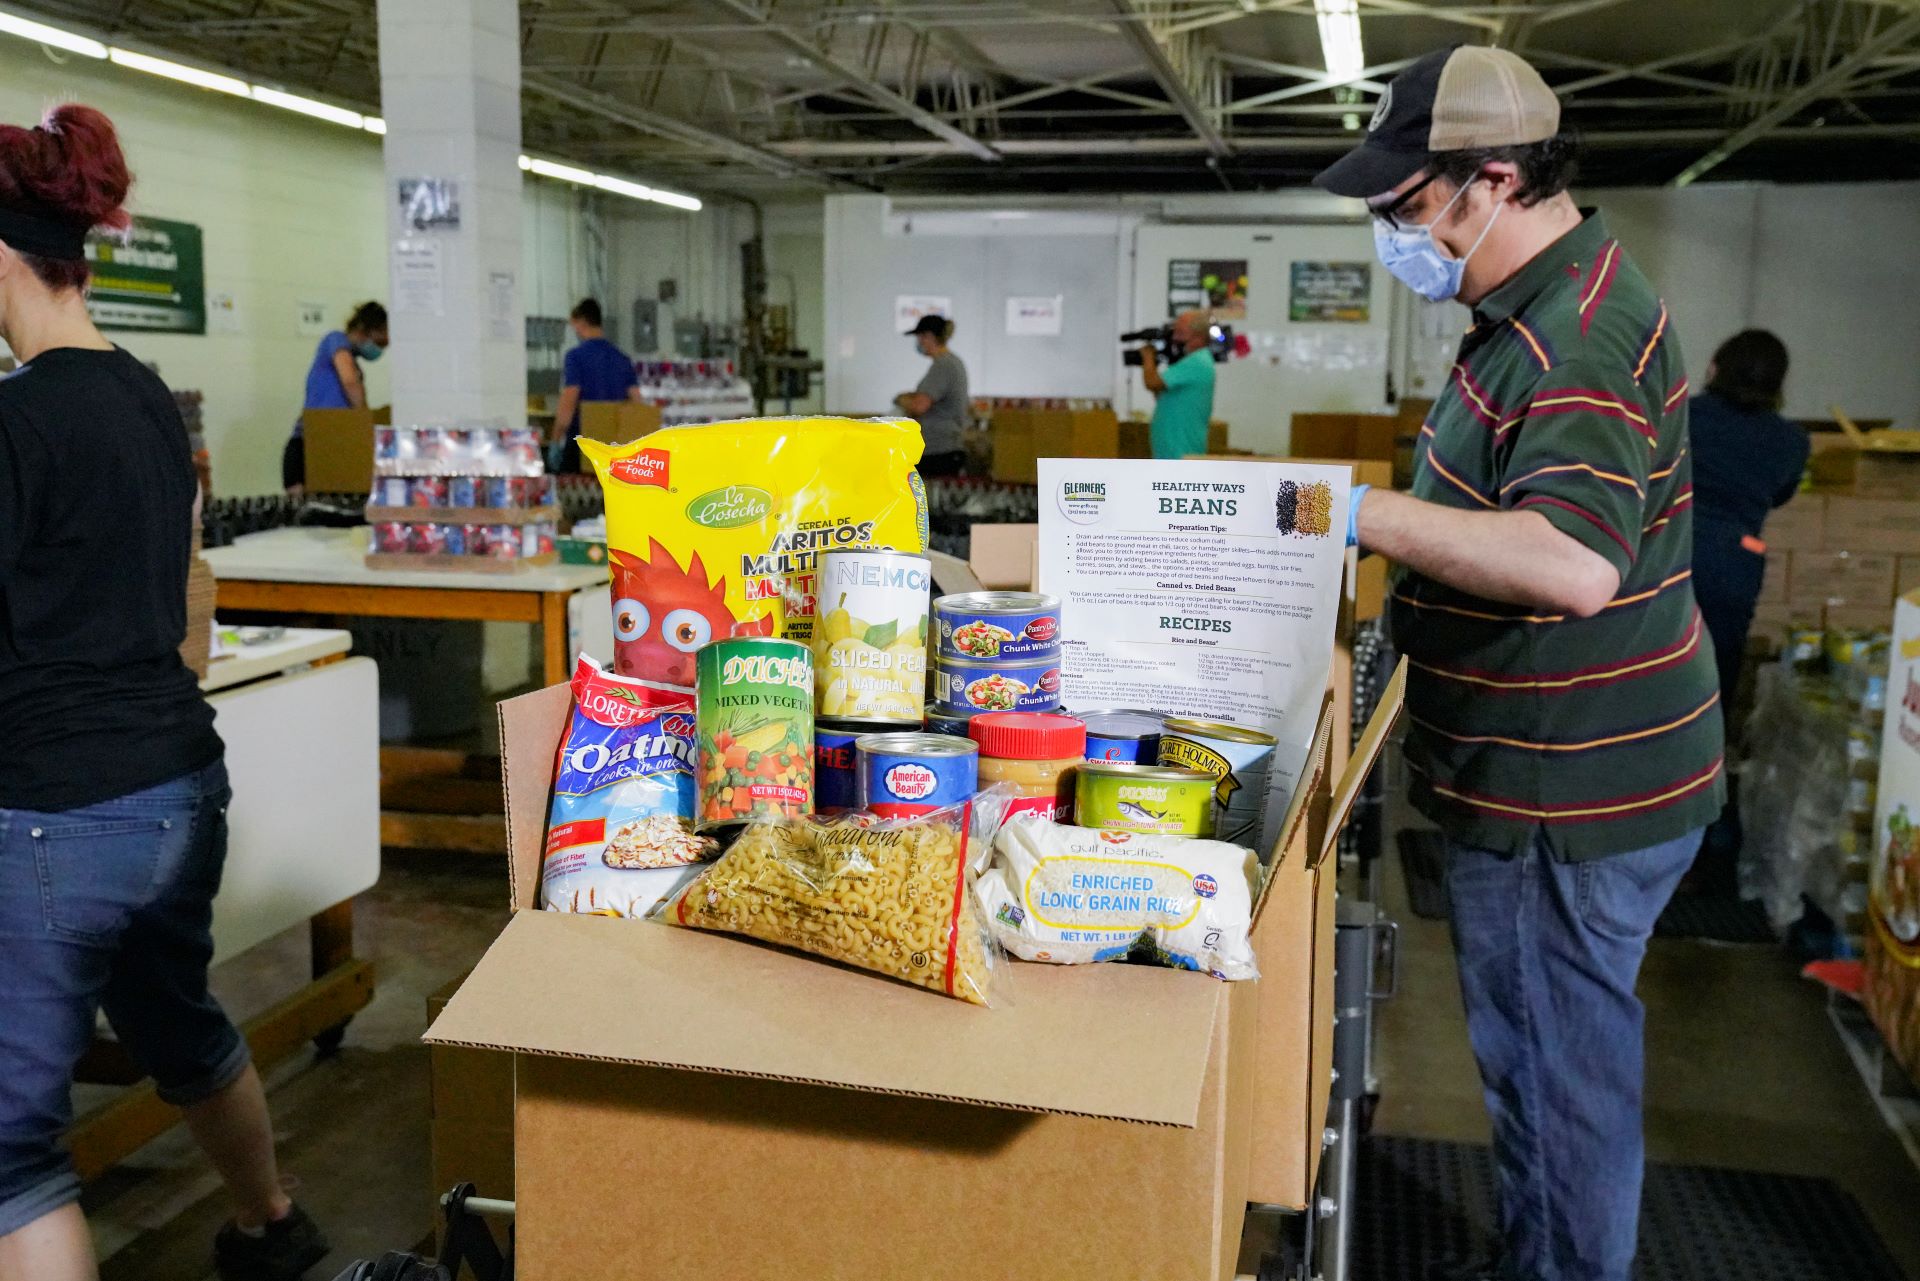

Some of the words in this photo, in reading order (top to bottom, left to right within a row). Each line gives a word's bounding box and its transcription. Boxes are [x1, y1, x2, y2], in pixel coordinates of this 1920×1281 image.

[626, 464, 654, 478] Foods
[1064, 482, 1106, 495] GLEANERS
[1152, 482, 1209, 493] HEALTHY
[1212, 483, 1245, 494] WAYS
[718, 485, 744, 508] La
[695, 498, 766, 525] Cosecha
[1158, 497, 1238, 516] BEANS
[797, 519, 833, 531] CEREAL
[837, 517, 851, 526] DE
[1168, 523, 1209, 533] Preparation
[1210, 525, 1227, 534] Tips:
[768, 521, 875, 552] ARITOS
[1159, 616, 1232, 633] RECIPES
[1003, 644, 1031, 653] Chunk
[1032, 642, 1051, 651] White
[831, 649, 892, 669] SLICED
[851, 676, 905, 693] NATURAL
[715, 694, 760, 709] MIXED
[1019, 697, 1043, 705] Chunk
[1203, 713, 1235, 721] Quesadillas
[571, 733, 695, 774] Oatm
[1183, 745, 1225, 777] HOLMES
[892, 770, 930, 782] American
[752, 786, 765, 795] NET
[767, 786, 777, 795] WT
[895, 782, 926, 796] Beauty
[570, 853, 585, 862] Fiber
[1072, 874, 1153, 891] ENRICHED
[1195, 880, 1215, 892] USA
[1040, 891, 1083, 909] LONG
[1089, 895, 1141, 912] GRAIN
[1147, 896, 1182, 915] RICE
[1061, 932, 1080, 941] NET
